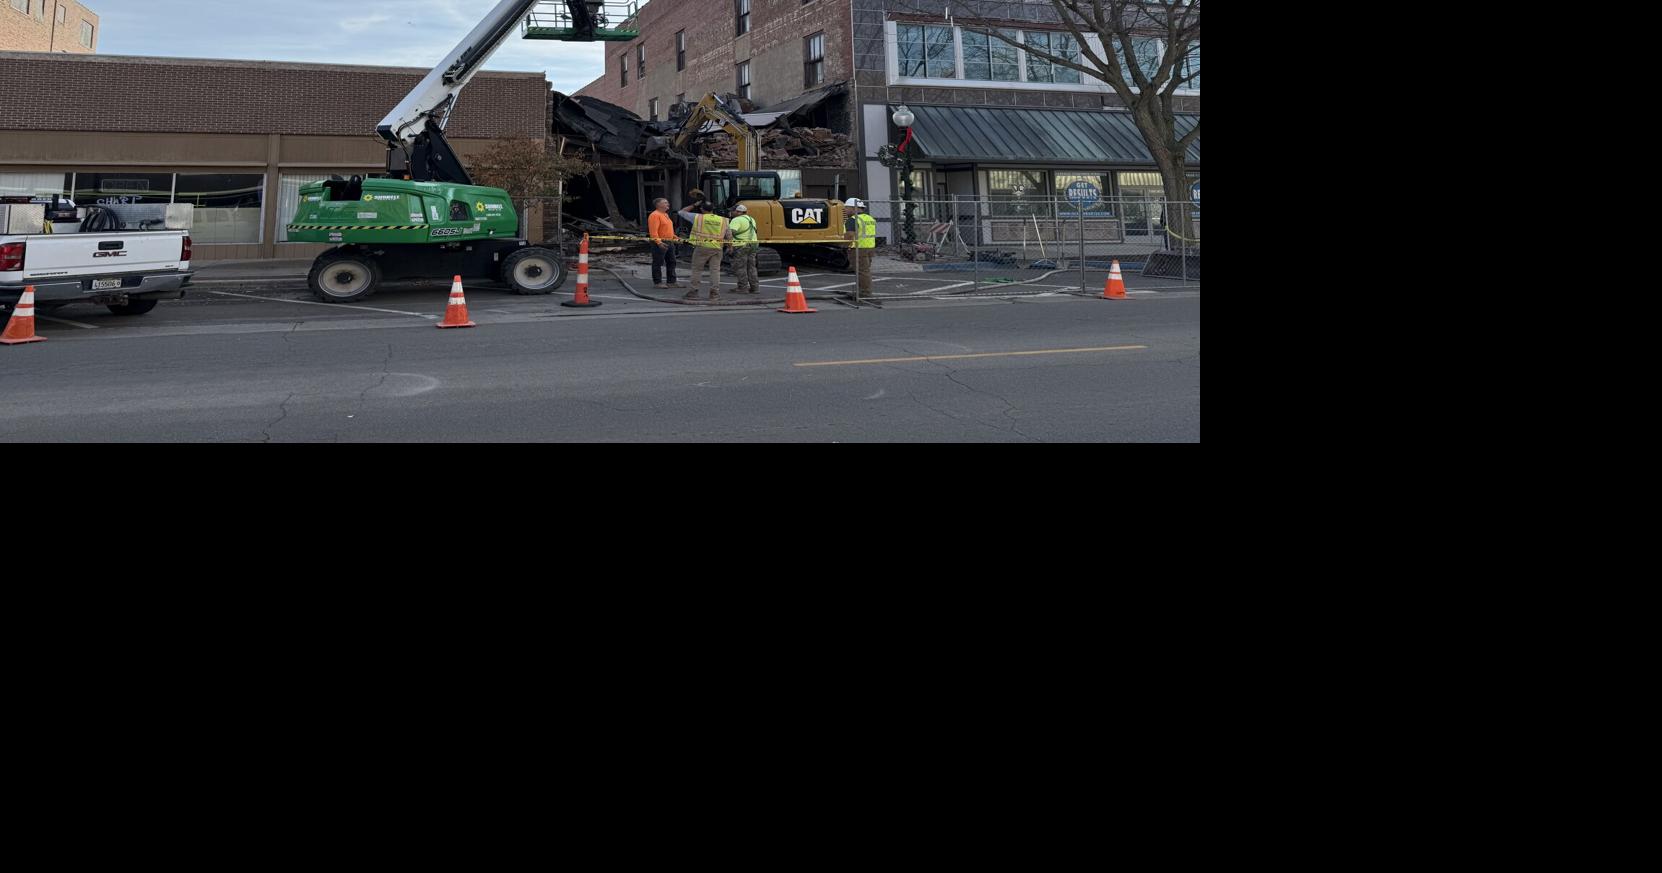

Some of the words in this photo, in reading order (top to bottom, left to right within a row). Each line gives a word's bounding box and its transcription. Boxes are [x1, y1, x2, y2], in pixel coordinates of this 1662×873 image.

[1068, 188, 1098, 200] RESULTS
[791, 208, 823, 224] CAT
[92, 250, 127, 258] GMC
